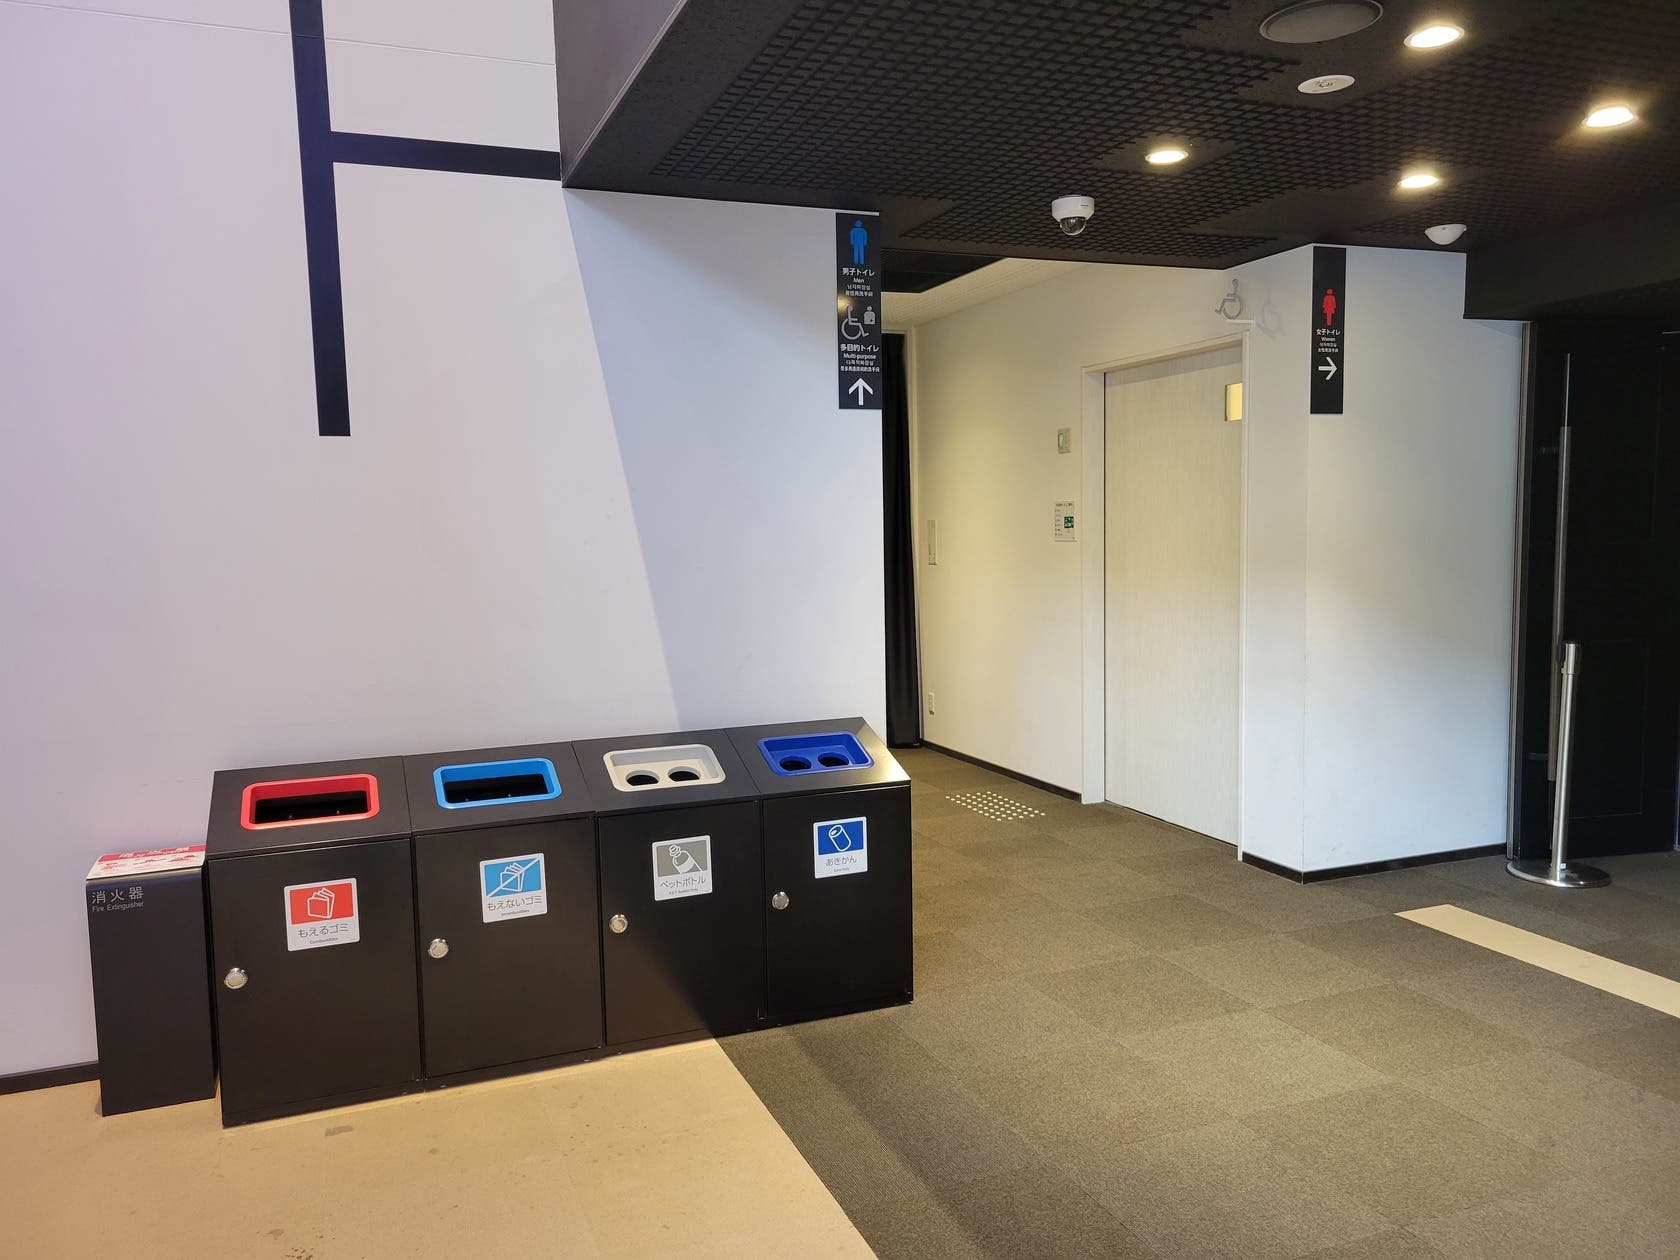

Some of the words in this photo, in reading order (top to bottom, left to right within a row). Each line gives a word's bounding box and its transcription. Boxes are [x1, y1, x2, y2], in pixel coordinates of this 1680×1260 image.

[842, 267, 875, 277] 男子トイレ
[1316, 328, 1341, 336] 女子トイレ
[840, 343, 879, 352] 多目的トイレ
[825, 855, 857, 867] あきかん
[659, 875, 707, 889] ペットボトル
[91, 886, 144, 905] 消火器
[92, 905, 105, 913] Fire
[106, 901, 145, 911] Extinguisher
[487, 895, 543, 911] もえないゴミ
[297, 923, 350, 938] もえるゴミ
